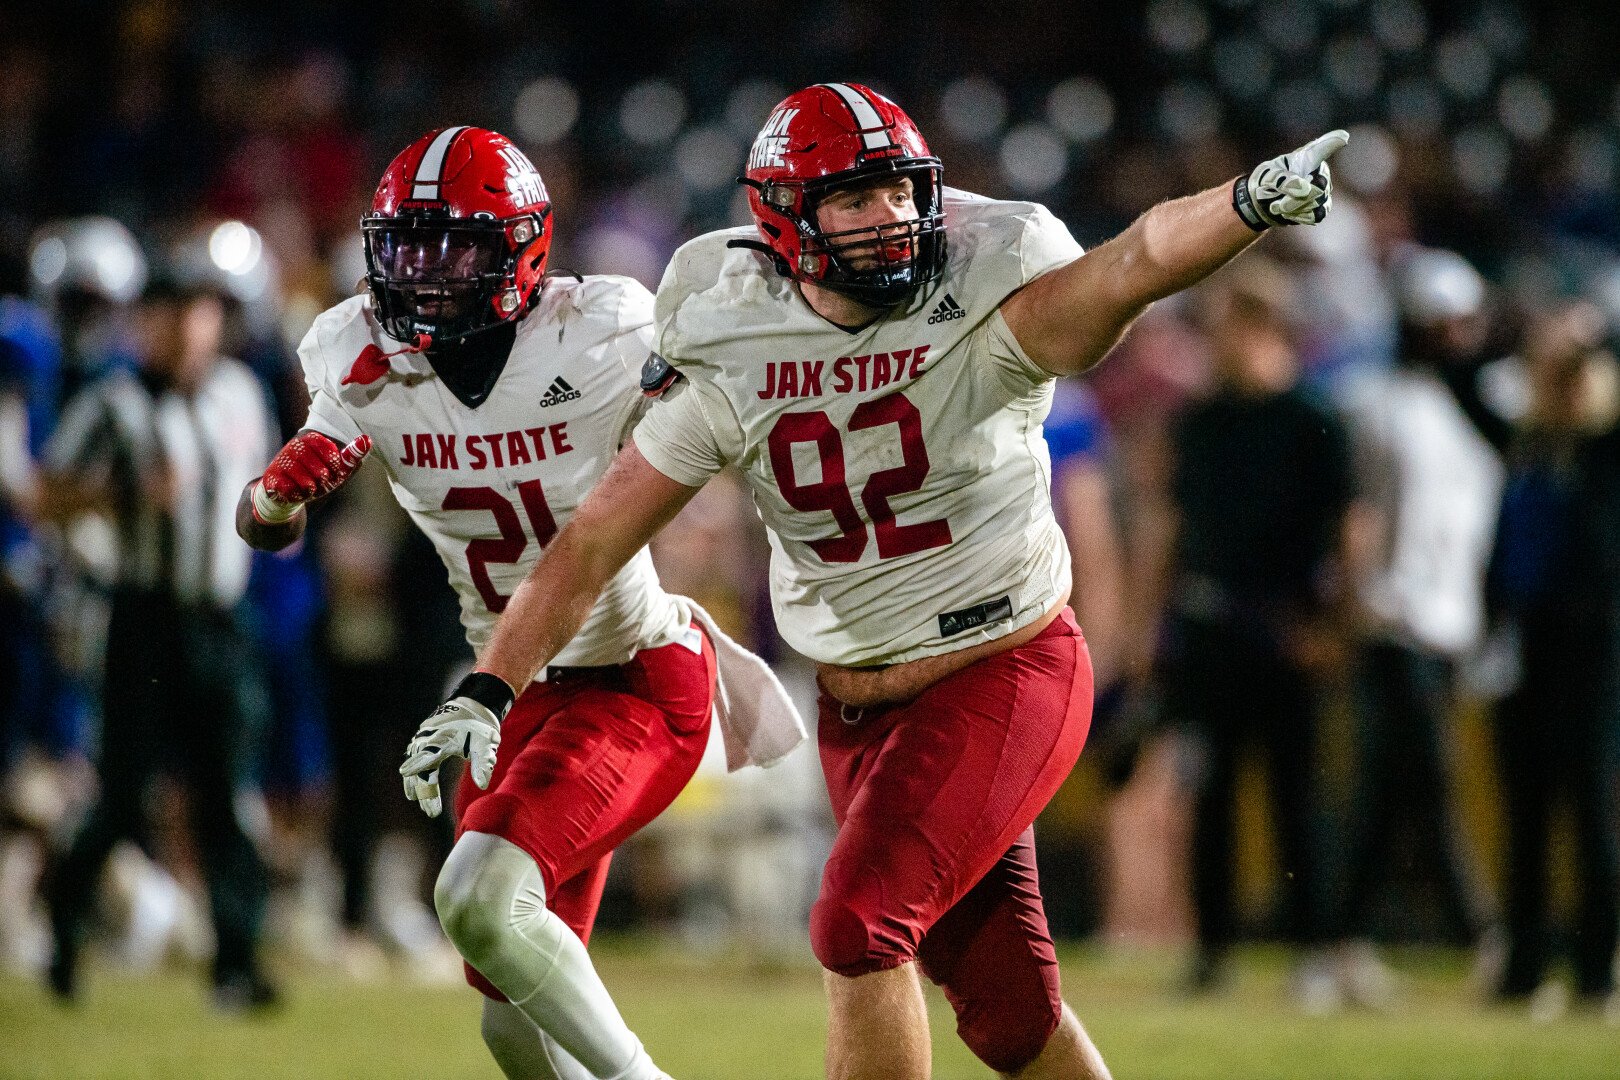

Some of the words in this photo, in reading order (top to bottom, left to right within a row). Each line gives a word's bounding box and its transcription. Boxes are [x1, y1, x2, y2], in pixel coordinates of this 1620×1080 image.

[928, 307, 966, 325] adidas
[539, 389, 582, 408] adidas
[757, 361, 825, 400] JAX
[833, 344, 931, 394] STATE
[400, 433, 459, 470] JAX
[465, 421, 574, 471] STATE
[767, 391, 953, 563] 92
[441, 479, 559, 614] 21
